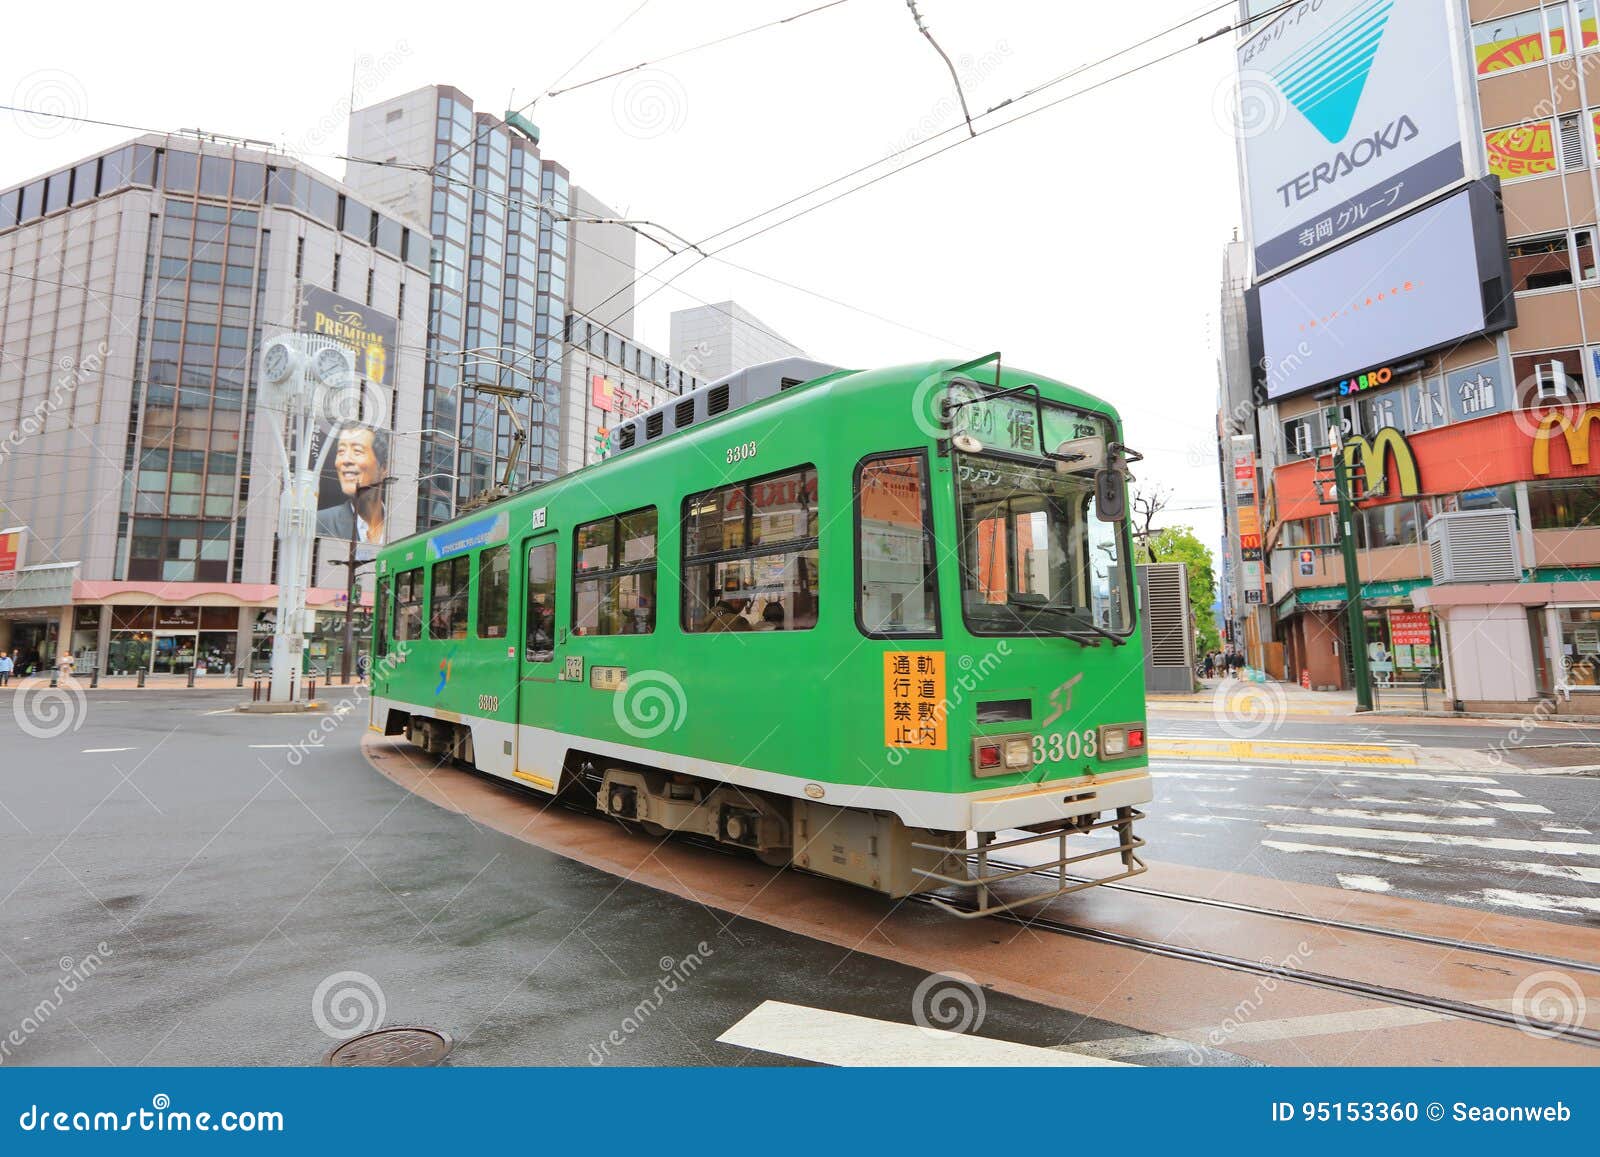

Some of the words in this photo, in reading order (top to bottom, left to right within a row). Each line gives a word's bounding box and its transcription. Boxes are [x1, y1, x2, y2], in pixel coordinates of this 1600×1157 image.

[1276, 114, 1419, 208] TERAOKA
[1298, 183, 1404, 247] 寺岡グループ
[314, 311, 384, 349] PREMIUM
[1339, 367, 1392, 396] SABRO
[726, 441, 757, 465] 3303
[959, 465, 1001, 485] ワンマン
[893, 655, 912, 746] 通行禁止
[917, 655, 937, 746] 軌道敷内
[1031, 729, 1099, 765] 3303
